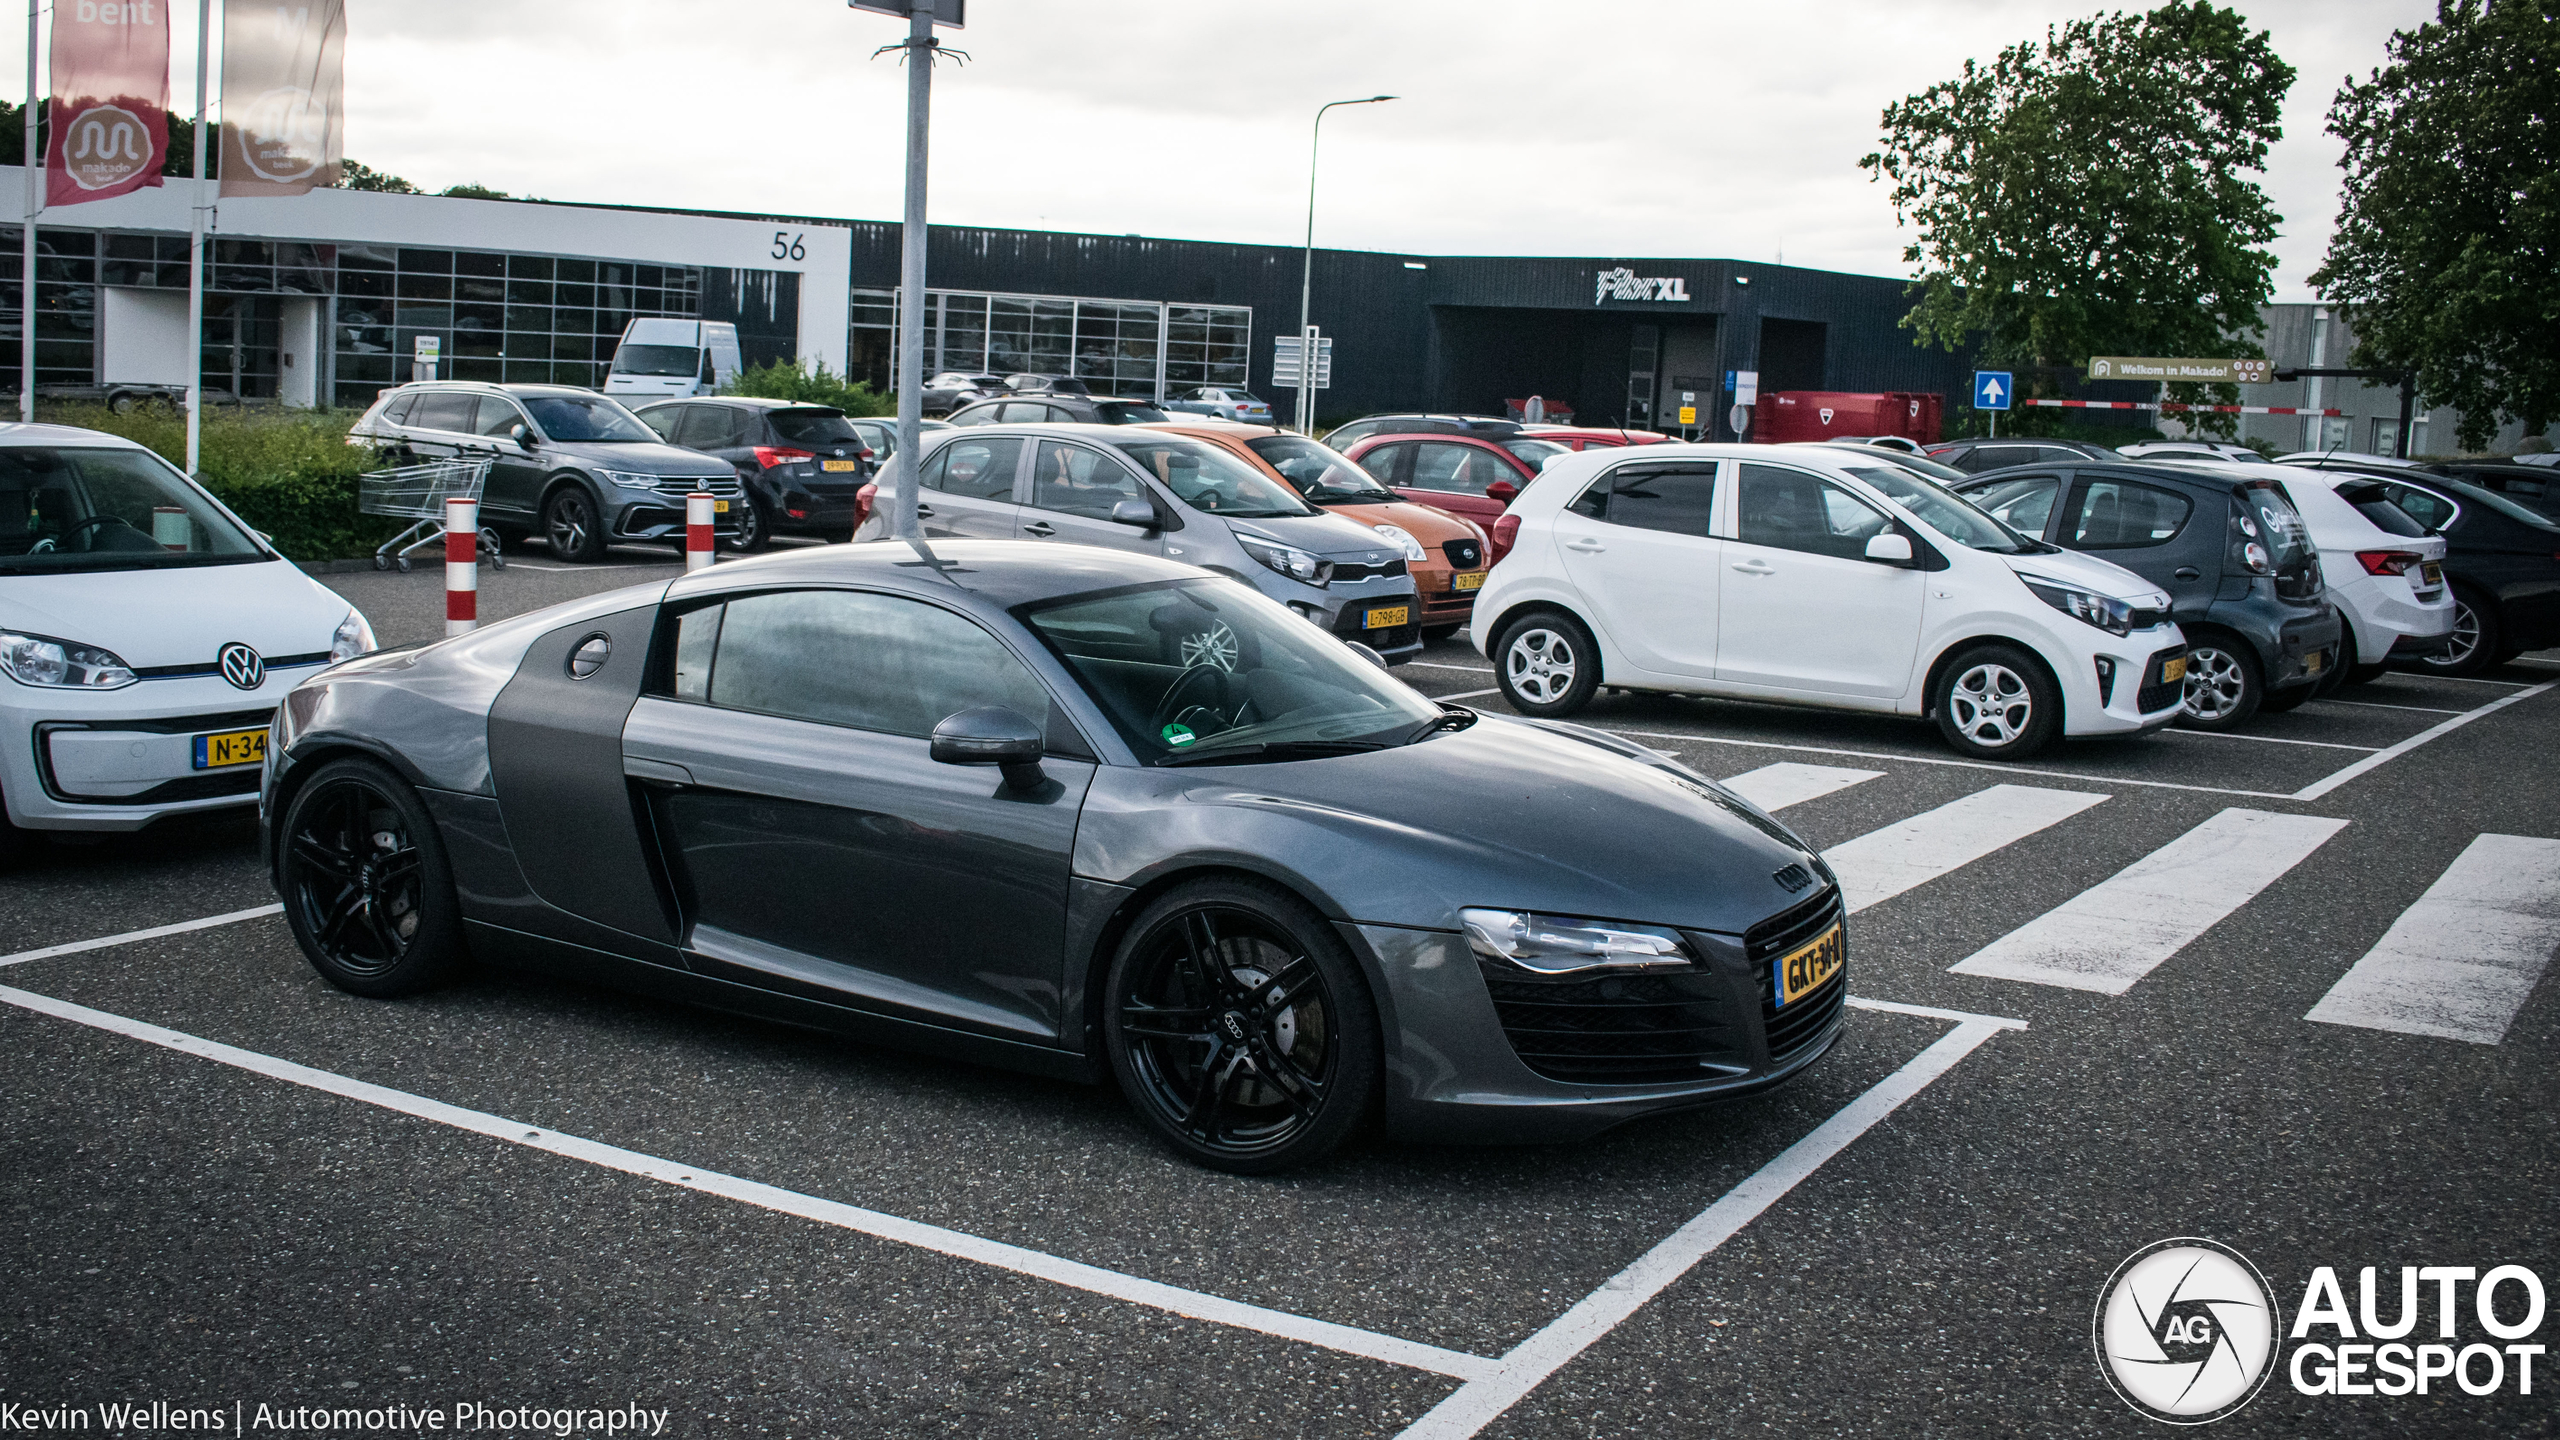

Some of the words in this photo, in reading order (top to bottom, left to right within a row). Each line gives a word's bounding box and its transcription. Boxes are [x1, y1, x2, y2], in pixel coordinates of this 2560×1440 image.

[77, 0, 154, 25] bent
[82, 162, 131, 174] makado
[771, 231, 806, 262] 56
[2120, 363, 2164, 375] Welkom
[2167, 365, 2178, 376] in
[2180, 366, 2228, 377] Makado!
[1370, 609, 1406, 626] L-798-GB
